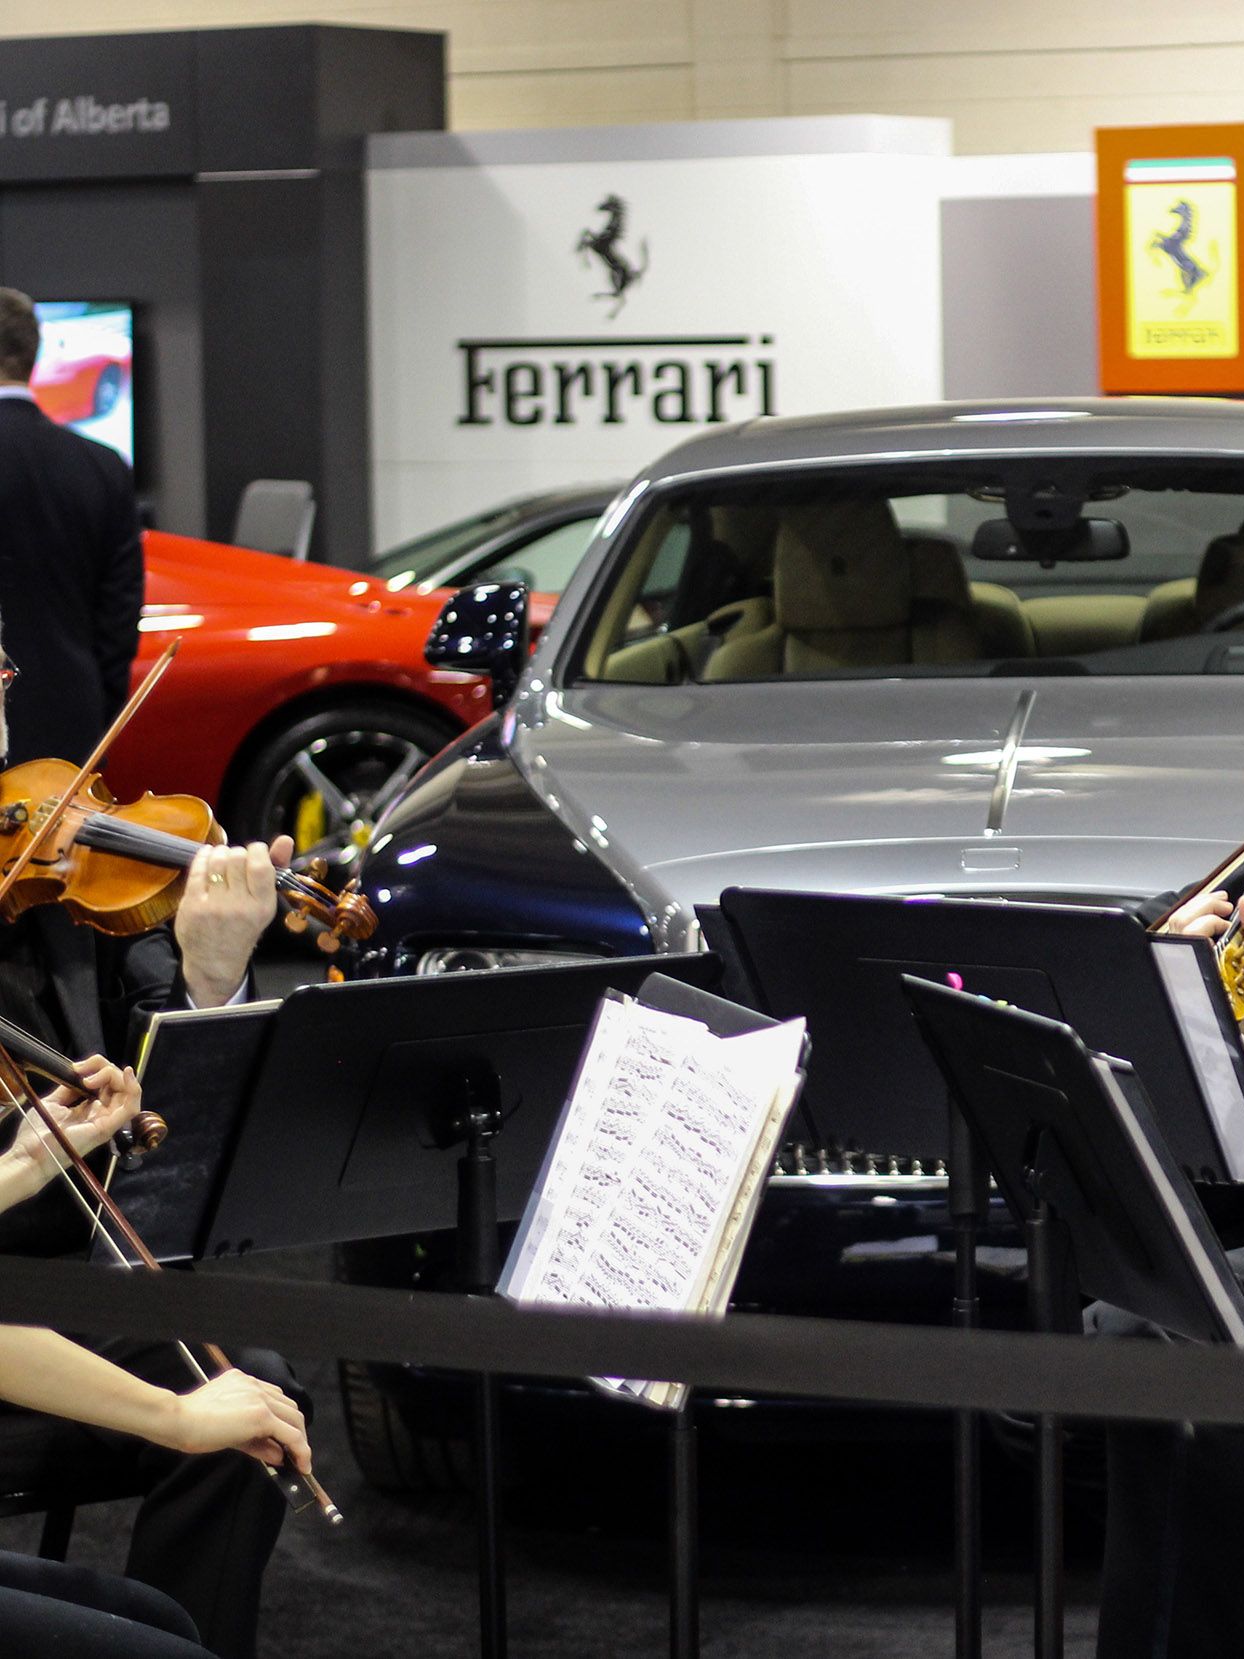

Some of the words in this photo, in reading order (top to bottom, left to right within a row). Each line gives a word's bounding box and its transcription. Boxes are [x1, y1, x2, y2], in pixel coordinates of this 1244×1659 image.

[10, 96, 49, 138] of
[50, 94, 171, 136] Alberta
[455, 333, 777, 426] Ferrari
